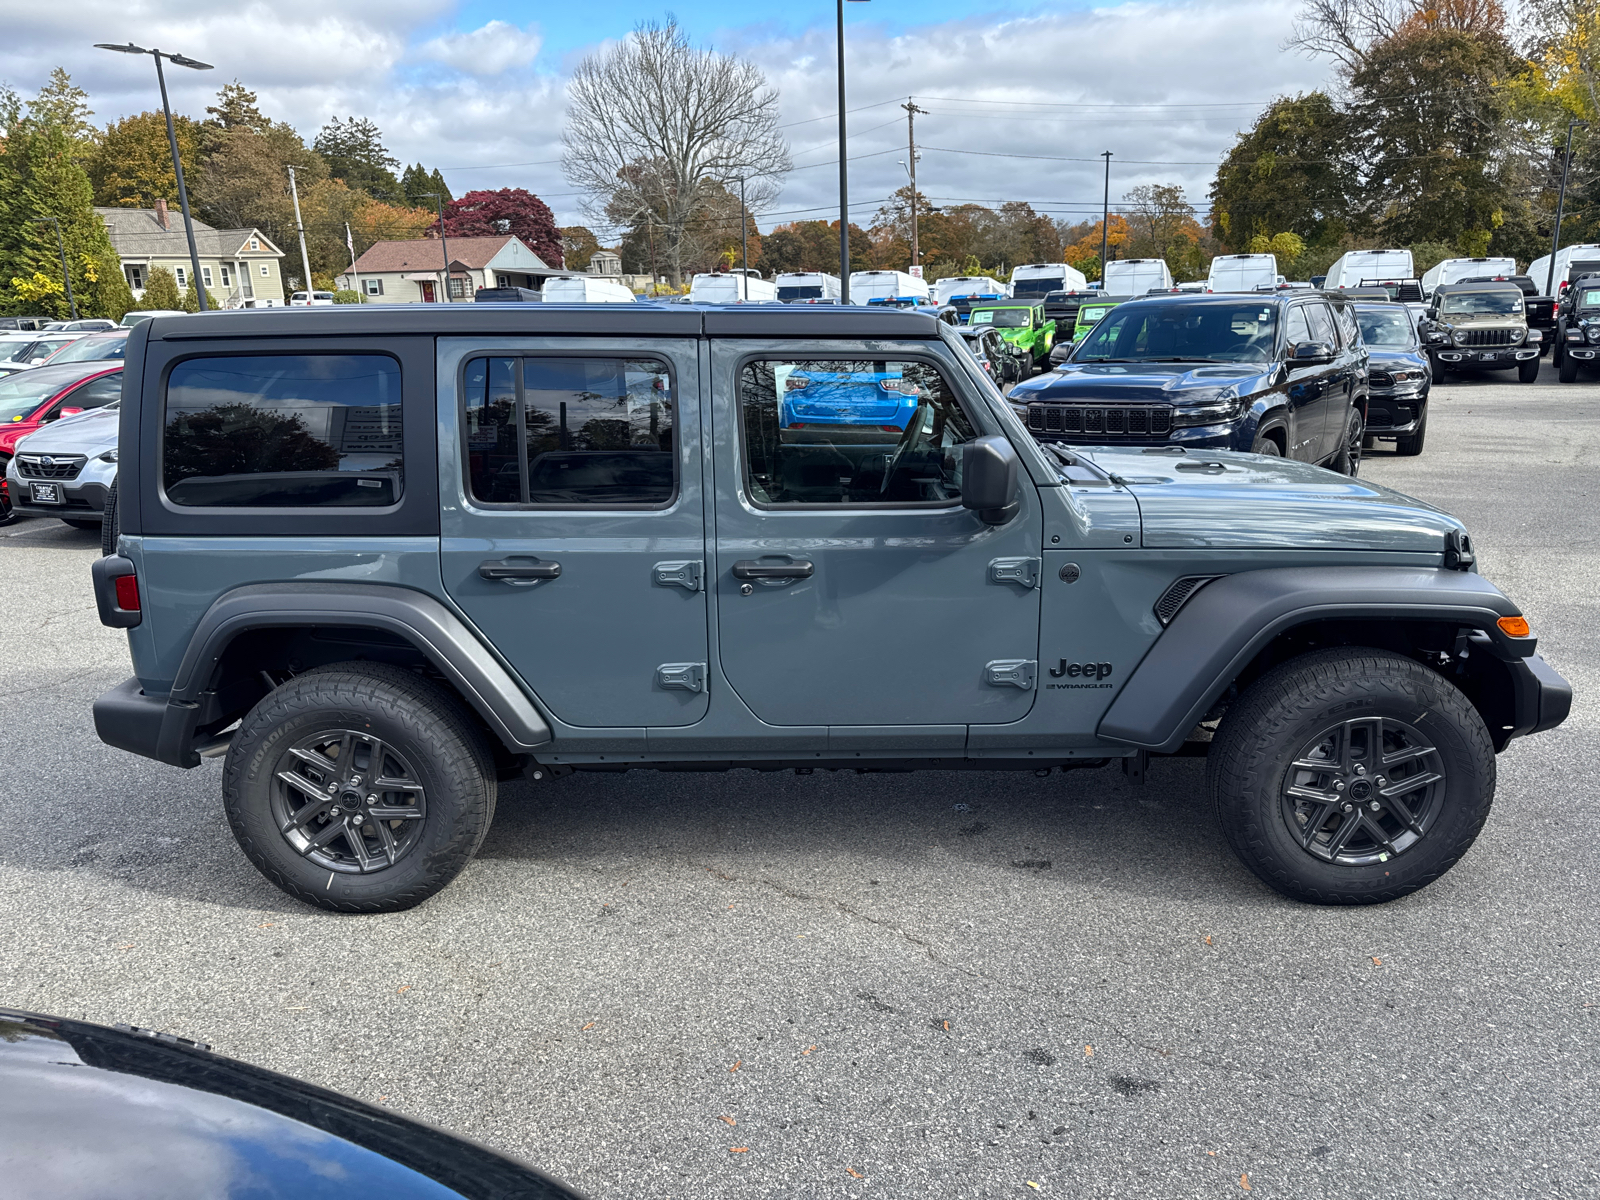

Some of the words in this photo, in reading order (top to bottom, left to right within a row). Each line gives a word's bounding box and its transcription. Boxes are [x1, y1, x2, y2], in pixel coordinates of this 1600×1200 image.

[1049, 657, 1113, 681] Jeep
[249, 715, 302, 773] ROADIAN
[1279, 699, 1363, 753] NEXEN
